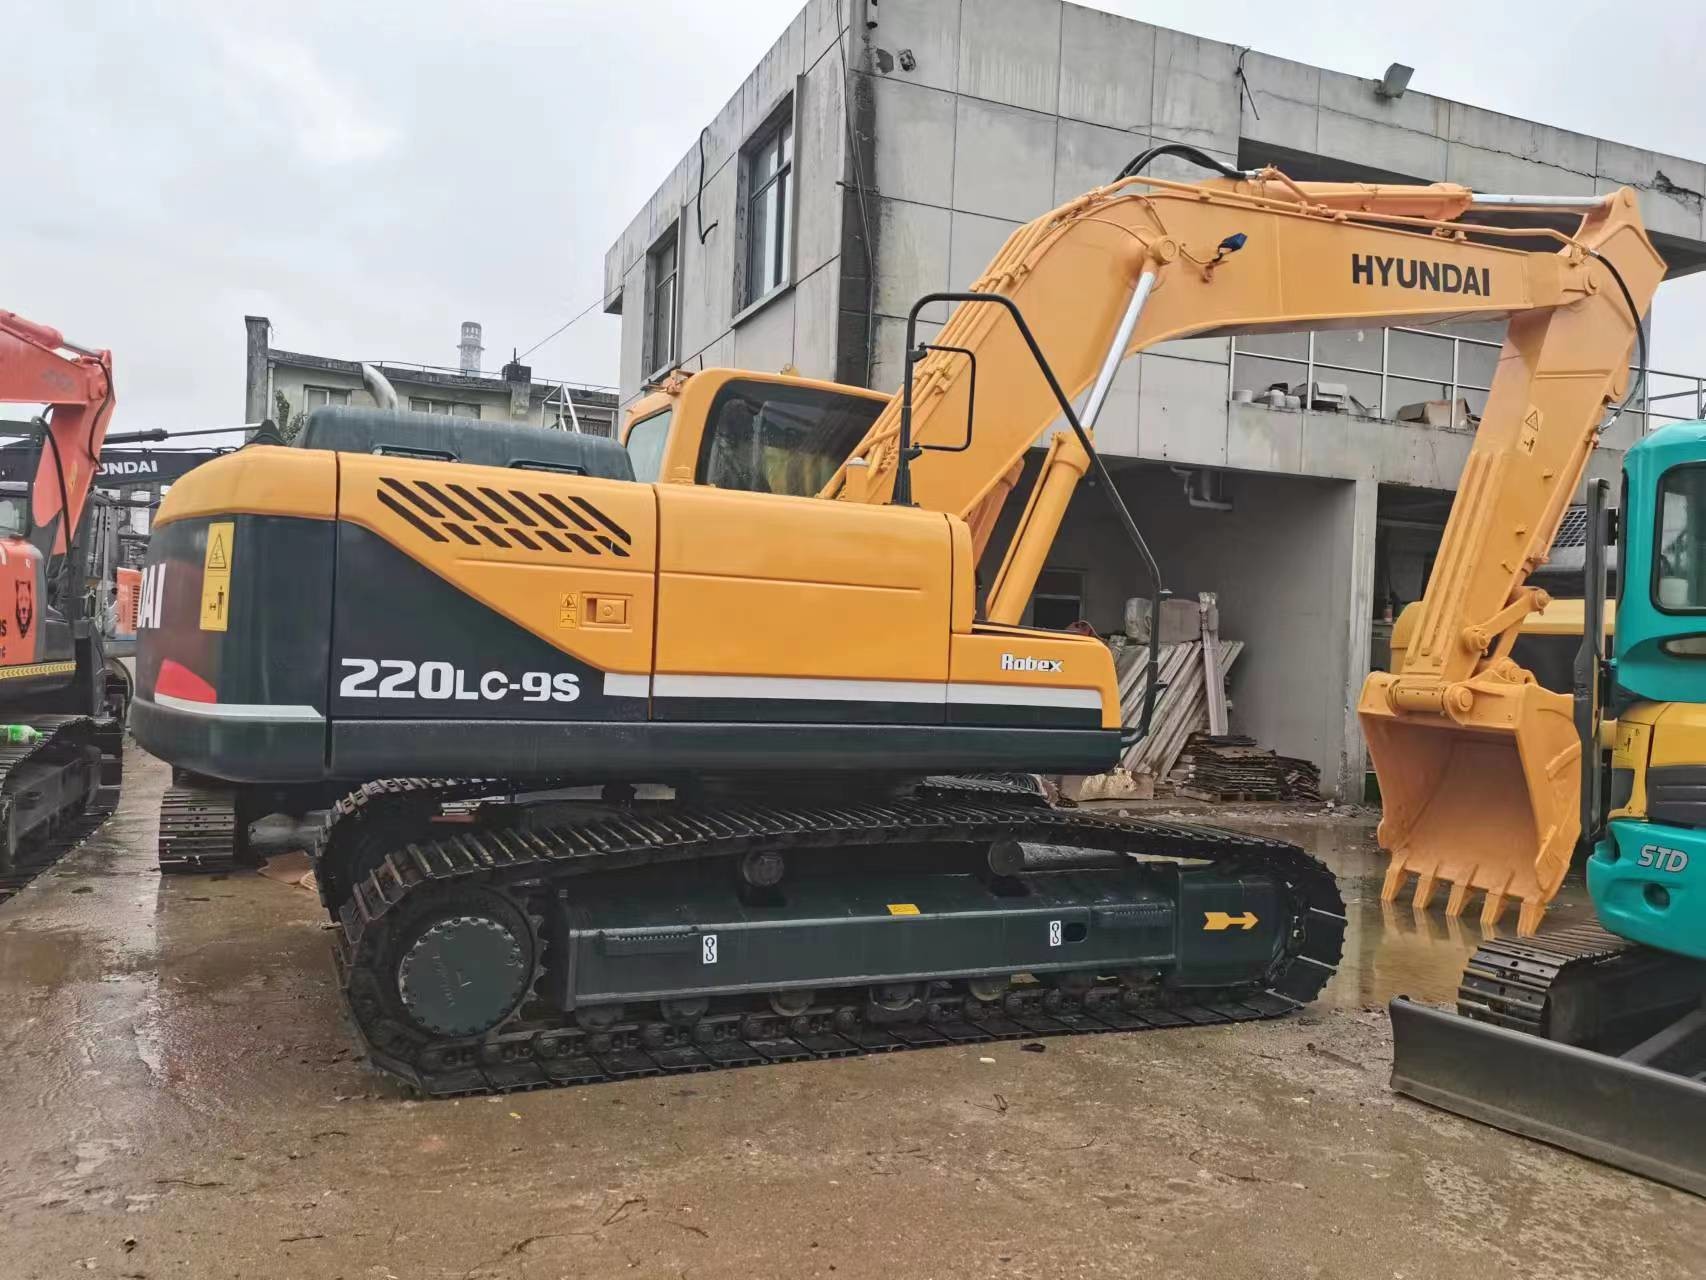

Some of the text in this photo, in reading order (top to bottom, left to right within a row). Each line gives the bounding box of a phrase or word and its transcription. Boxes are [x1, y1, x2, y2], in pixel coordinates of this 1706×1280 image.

[1352, 253, 1490, 296] HYUNDAI
[340, 658, 580, 701] 220LC-9S
[1001, 653, 1064, 672] Robex
[1637, 844, 1688, 873] STD
